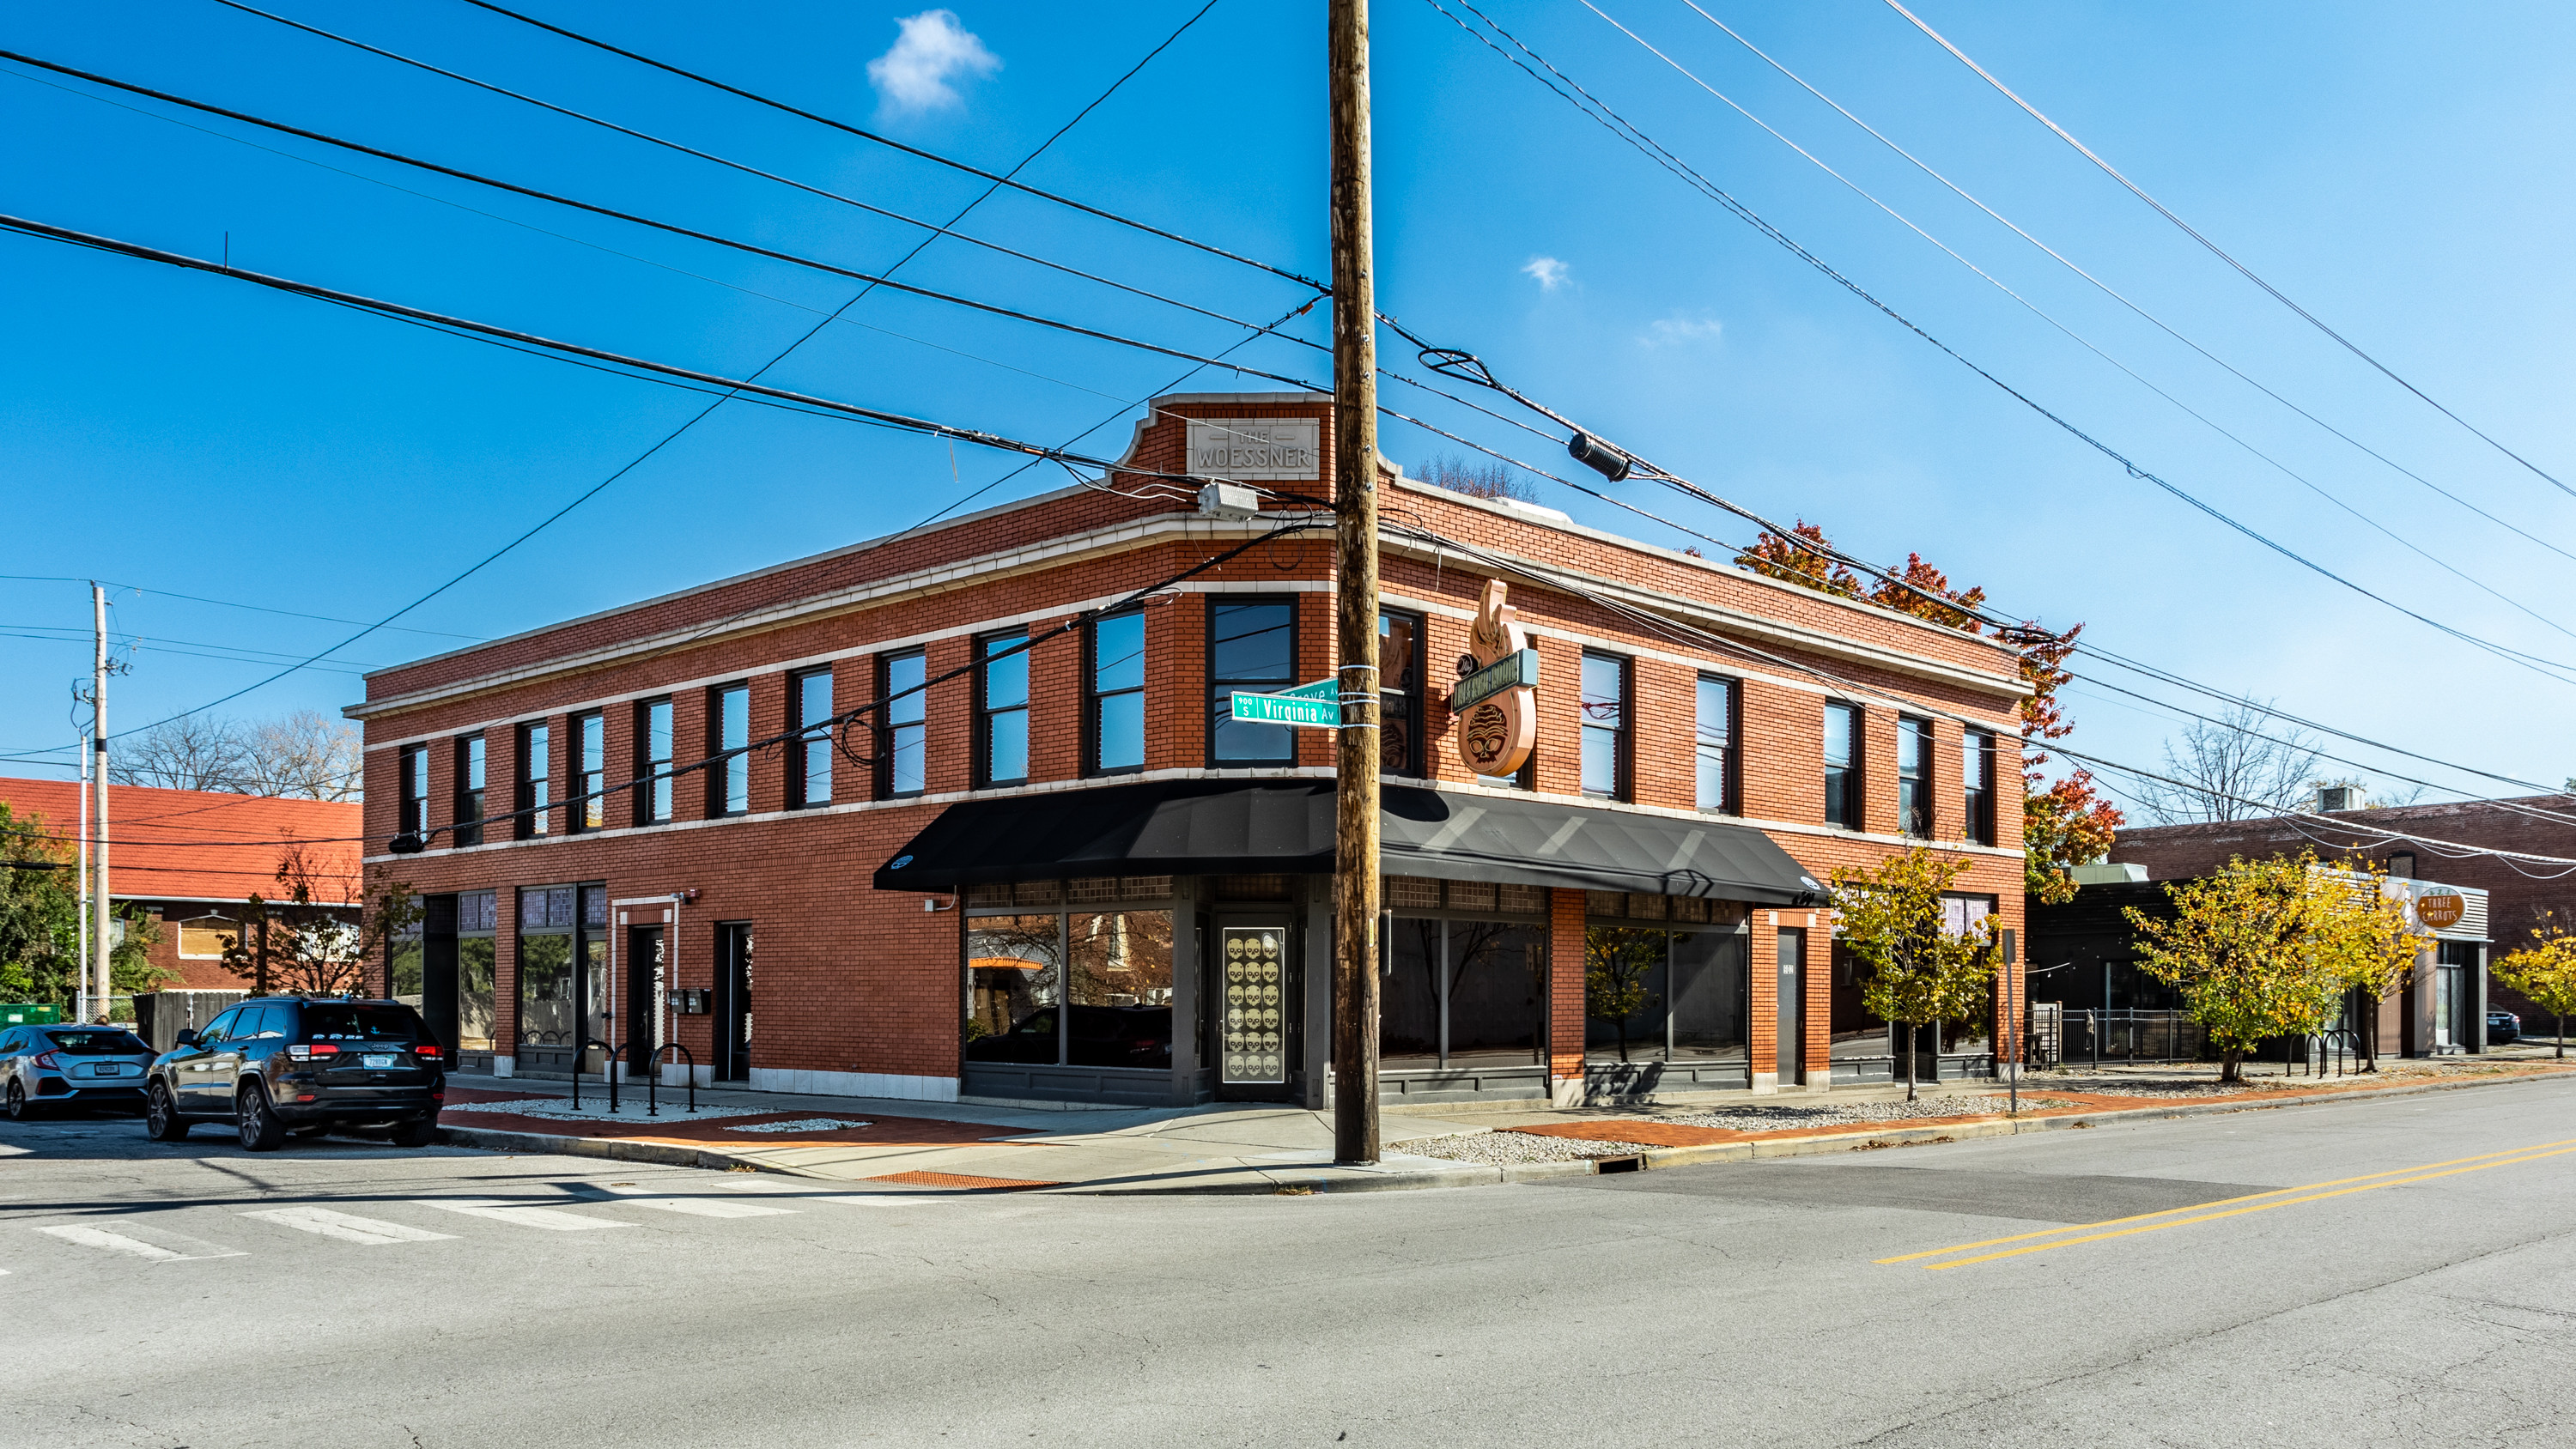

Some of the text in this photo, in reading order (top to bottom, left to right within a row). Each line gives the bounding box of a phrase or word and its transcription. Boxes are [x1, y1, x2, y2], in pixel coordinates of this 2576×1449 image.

[1239, 431, 1269, 444] THE
[1197, 447, 1311, 468] WOESSNER
[1242, 706, 1249, 716] S
[1264, 700, 1334, 722] Virginia Av
[2427, 897, 2451, 908] THREE
